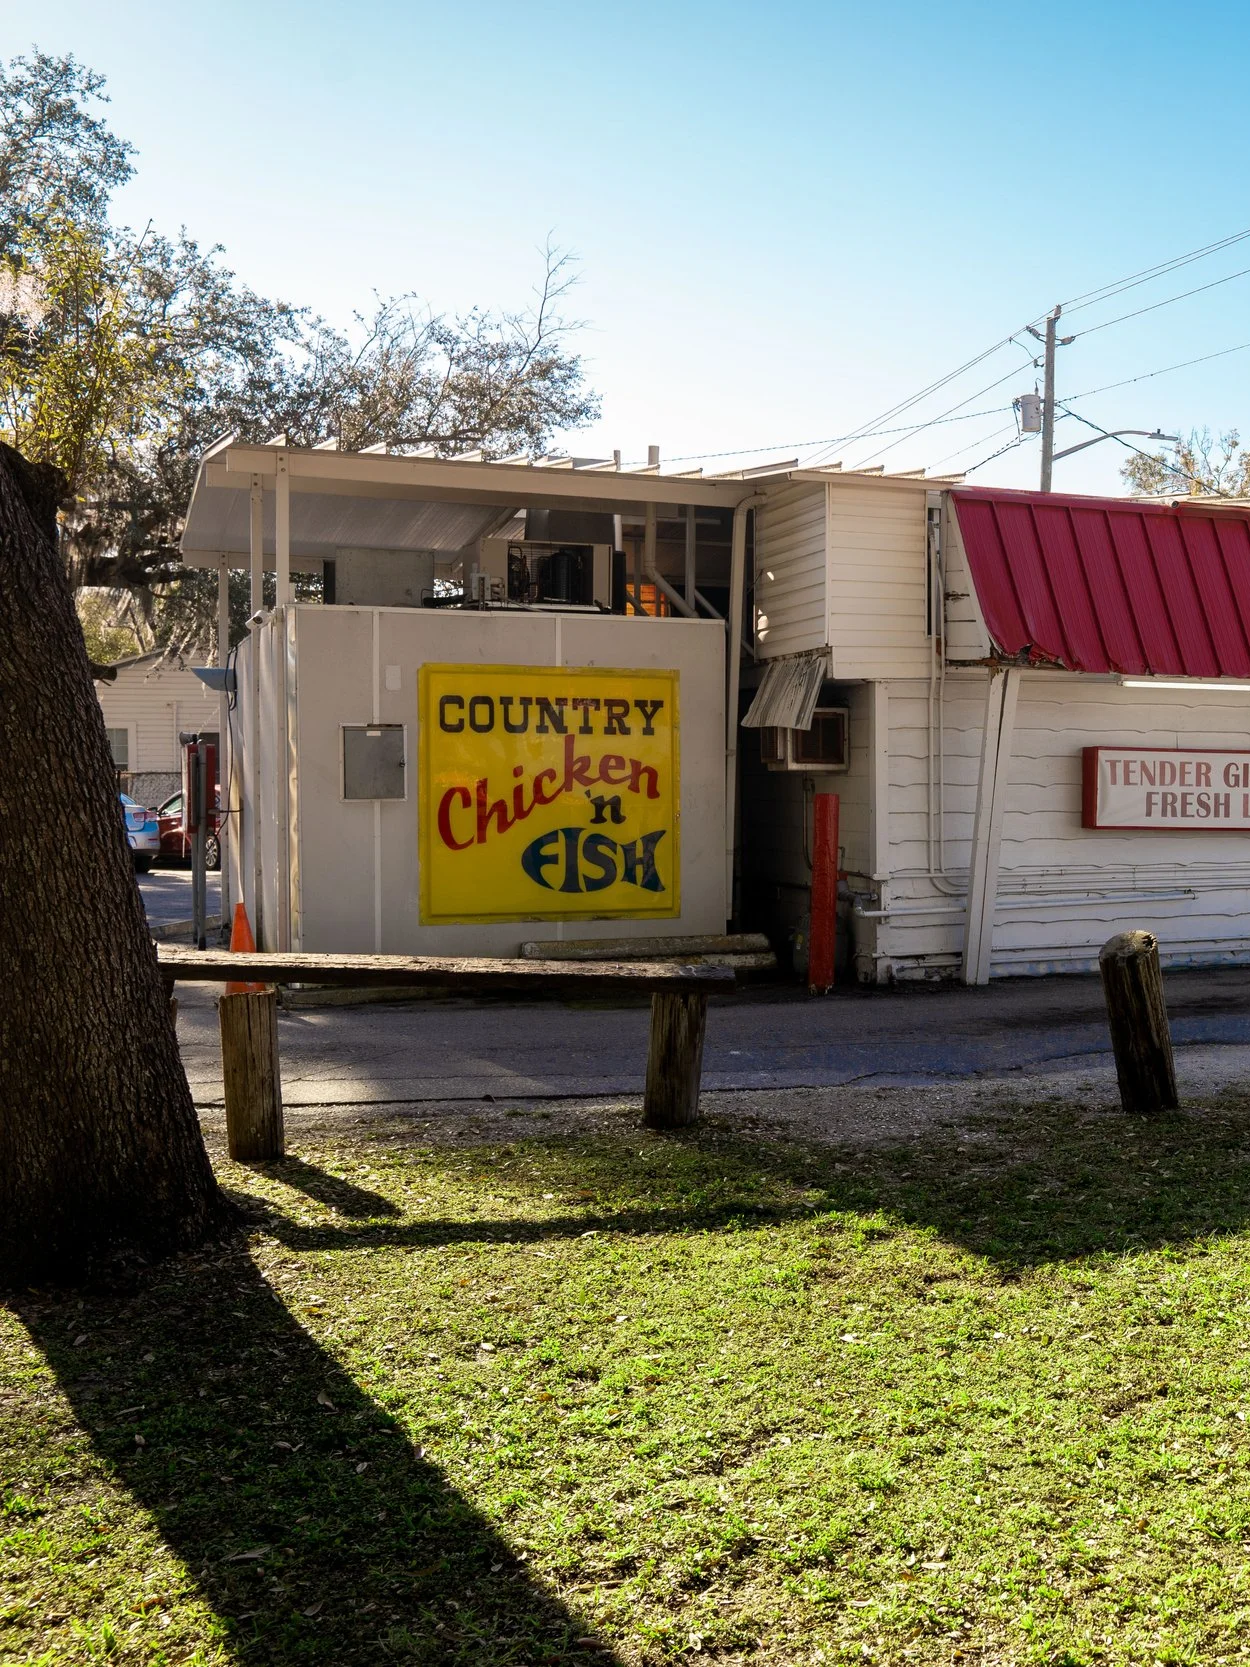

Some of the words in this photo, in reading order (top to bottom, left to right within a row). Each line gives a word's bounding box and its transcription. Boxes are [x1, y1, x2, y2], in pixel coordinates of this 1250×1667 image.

[438, 694, 664, 735] COUNTRY
[438, 733, 660, 850] Chicken
[1105, 759, 1212, 787] TENDER
[1145, 791, 1231, 818] FRESH
[521, 827, 667, 893] FISH
